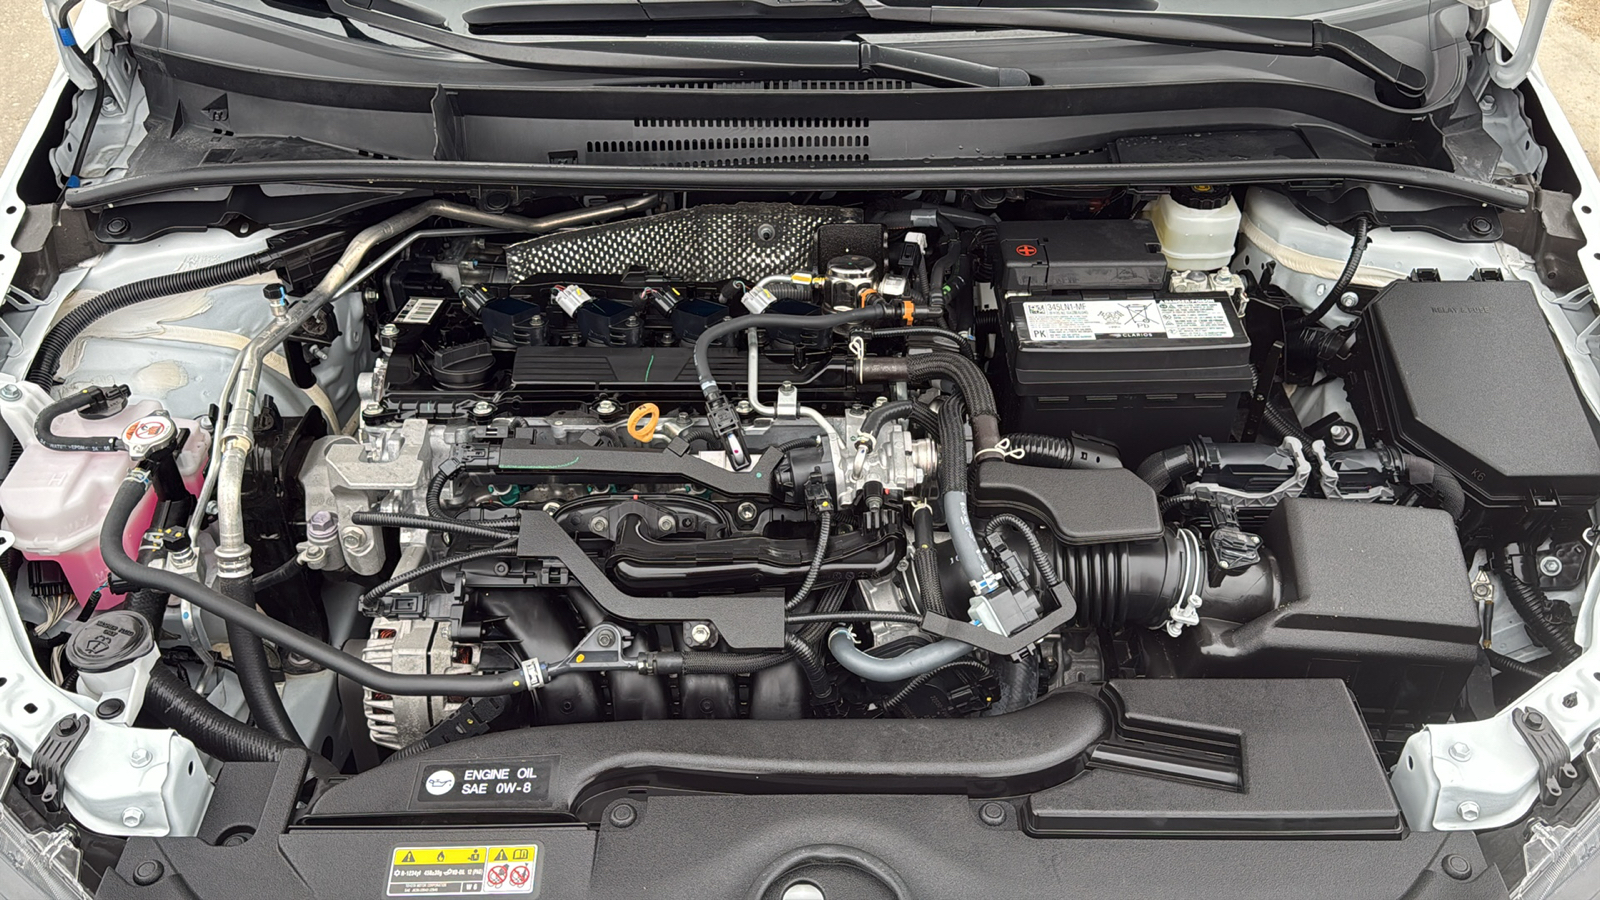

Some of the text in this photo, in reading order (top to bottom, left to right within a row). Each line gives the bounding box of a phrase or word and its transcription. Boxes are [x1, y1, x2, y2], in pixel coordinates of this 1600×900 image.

[1033, 330, 1047, 338] PK
[1471, 468, 1486, 482] K6
[464, 767, 537, 780] ENGINE OIL
[461, 782, 532, 795] SAE 0W-8
